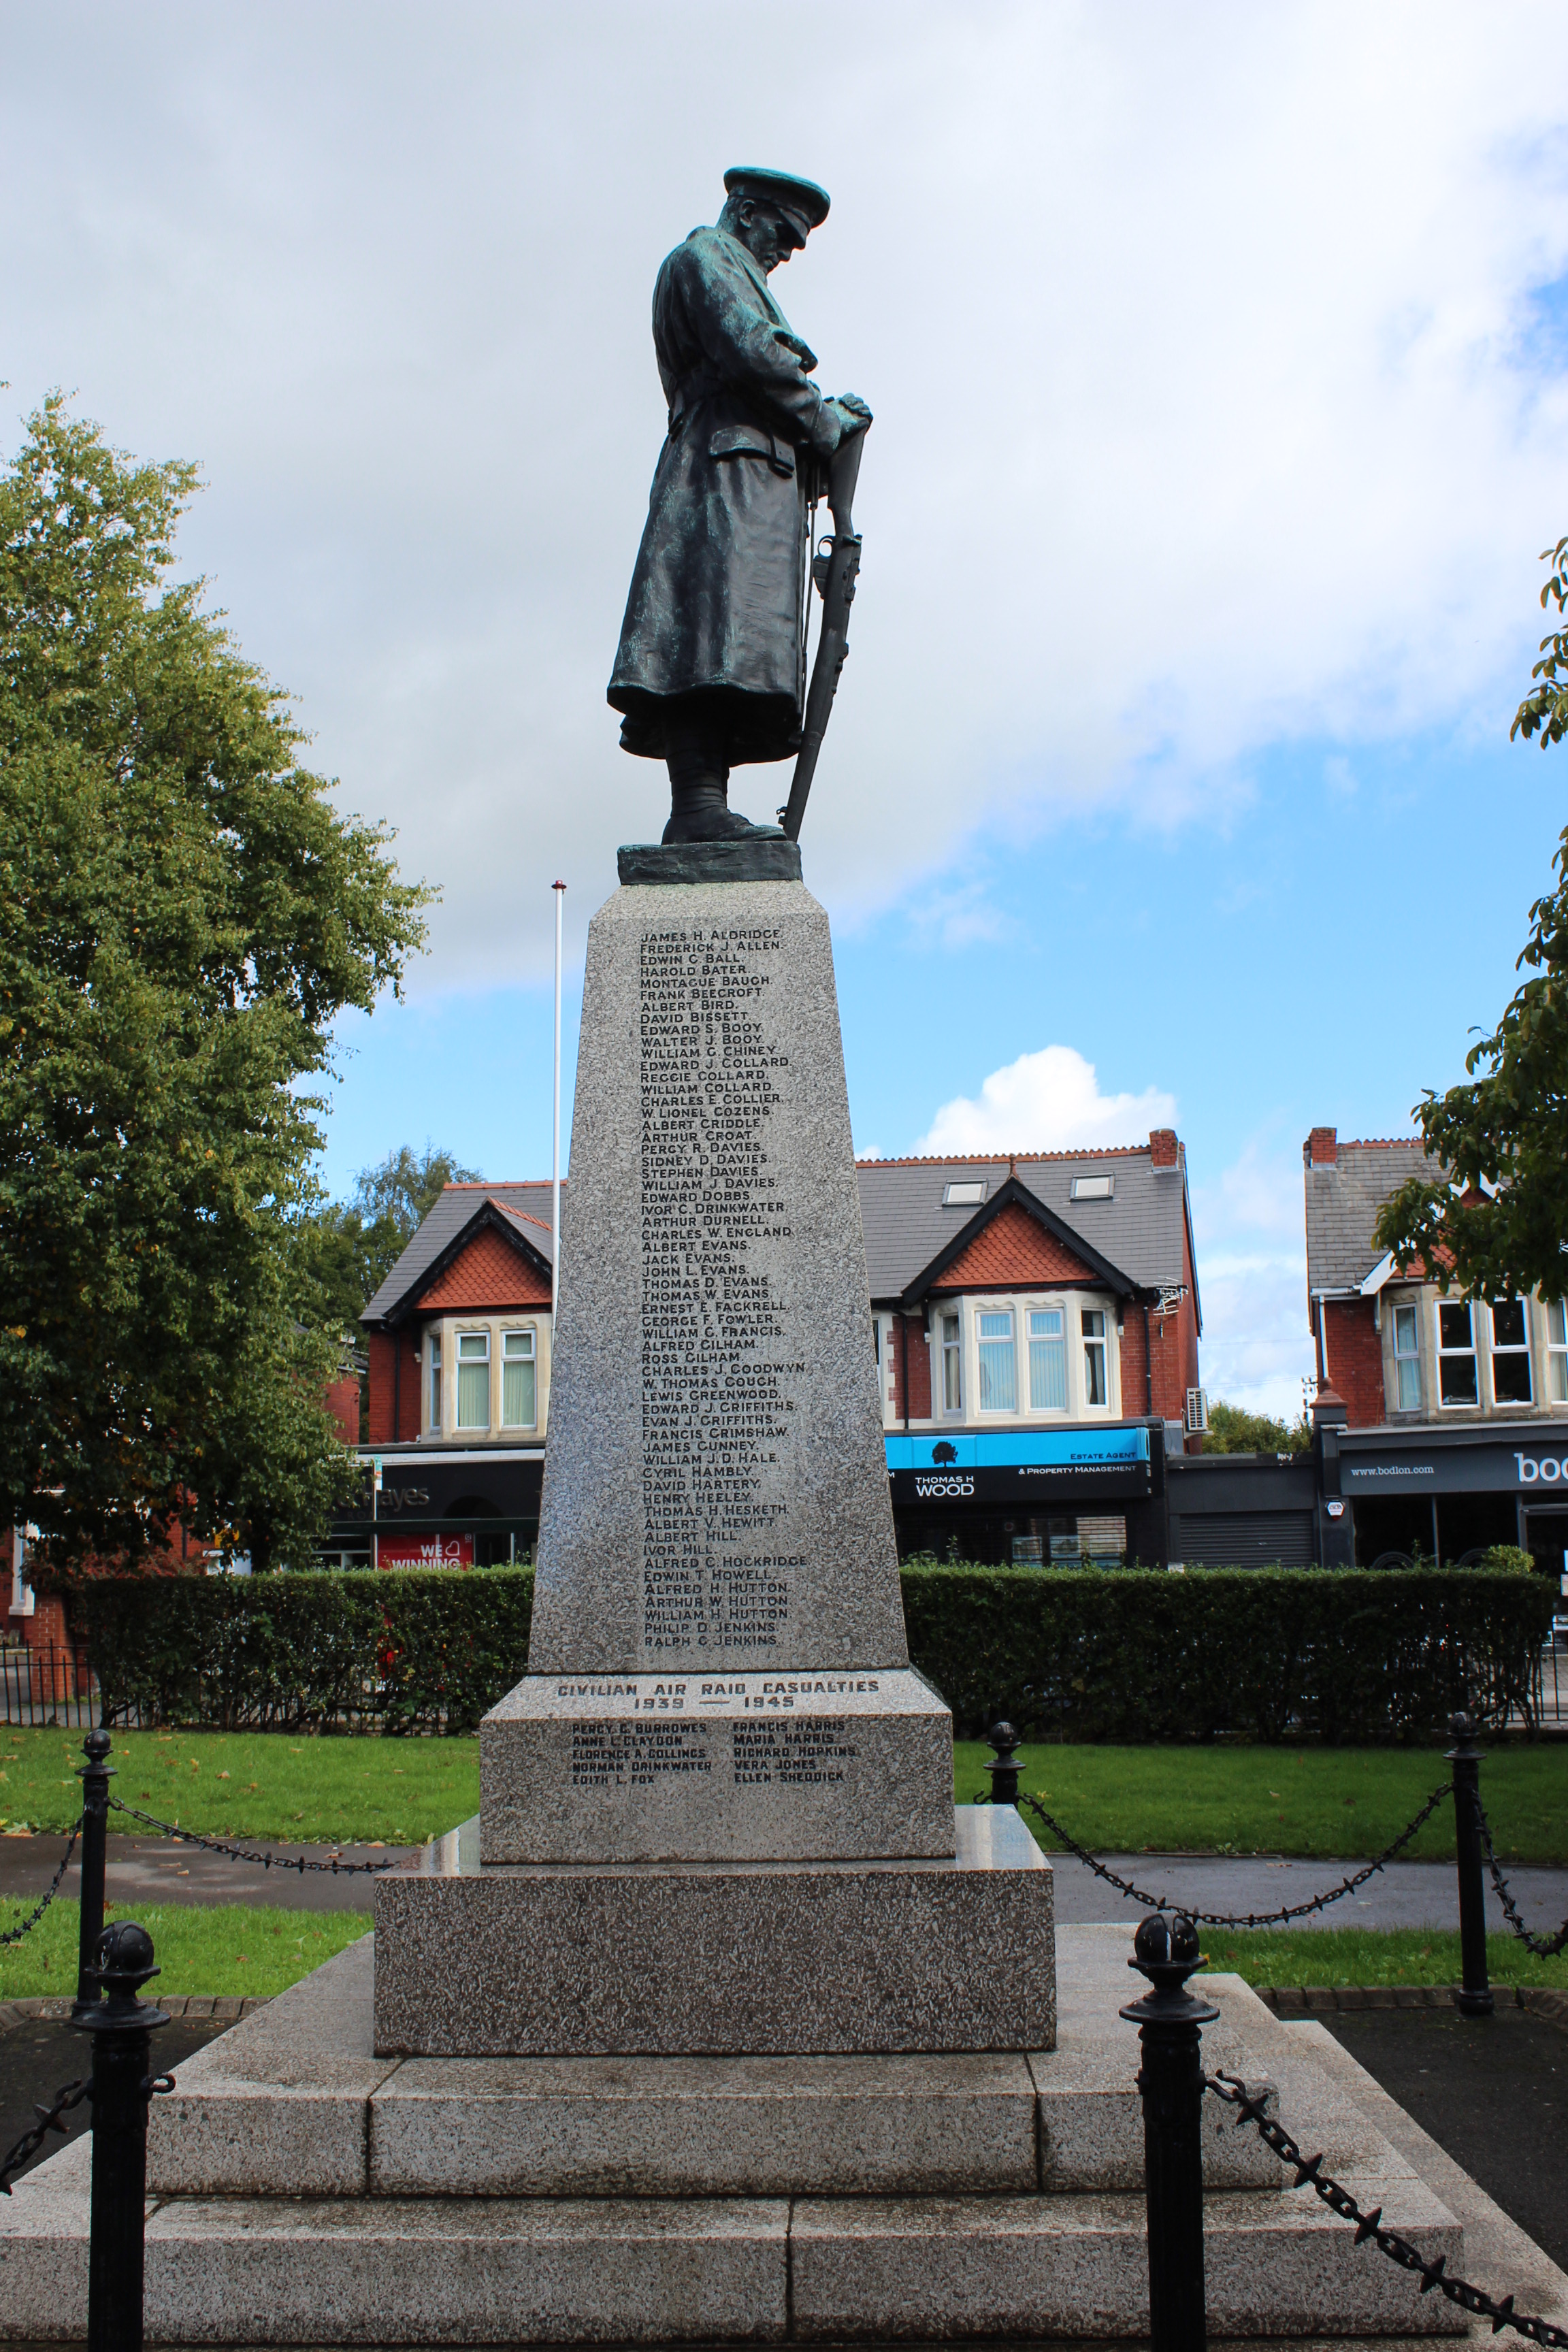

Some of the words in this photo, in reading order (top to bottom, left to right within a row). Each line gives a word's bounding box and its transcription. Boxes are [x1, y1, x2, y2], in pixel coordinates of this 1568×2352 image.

[642, 933, 686, 943] JAMES
[641, 944, 714, 954] FREDERICK
[641, 956, 682, 965] EDWIN
[641, 968, 696, 977] HAROLD
[641, 991, 685, 1000] FRANK
[642, 1002, 693, 1012] ALBERT
[641, 1014, 683, 1024] DAVID
[641, 1026, 700, 1035] EDWARD
[642, 1037, 697, 1047] WALTER
[642, 1049, 700, 1058] WILLIAM
[641, 1062, 699, 1071] EDWARD
[641, 1085, 698, 1094] WILLIAM
[641, 1097, 703, 1107] CHARLES
[660, 1109, 706, 1117] LIONEL
[642, 1121, 694, 1130] ALBERT
[642, 1133, 697, 1143] ARTHUR
[642, 1157, 692, 1166] SIDNEY
[642, 1169, 703, 1179] STEPHEN
[642, 1181, 702, 1190] WILLIAM
[642, 1193, 697, 1203] EDWARD
[642, 1206, 672, 1215] IVOR
[642, 1218, 696, 1227] ARTHUR
[642, 1230, 702, 1240] CHARLES
[642, 1242, 696, 1252] ALBERT
[642, 1256, 678, 1264] JACK
[642, 1267, 680, 1277] JOHN
[642, 1279, 699, 1289] THOMAS
[643, 1291, 700, 1302] THOMAS
[642, 1304, 693, 1314] ERNEST
[642, 1329, 698, 1339] WILLIAM
[643, 1341, 694, 1351] ALFRED
[642, 1354, 677, 1364] ROSS
[642, 1366, 708, 1376] CHARLES
[662, 1379, 717, 1388] THOMAS
[642, 1392, 682, 1401] LEWIS
[642, 1404, 698, 1414] EDWARD
[643, 1417, 678, 1427] EVAN
[643, 1430, 702, 1440] FRANCIS
[643, 1442, 690, 1452] JAMES
[643, 1454, 701, 1465] WILLIAM
[643, 1468, 685, 1477] CYRIL
[1351, 1466, 1434, 1476] www.bodlon.com
[644, 1481, 685, 1491] DAVID
[916, 1484, 974, 1497] WOOD
[644, 1493, 690, 1504] HENRY
[644, 1506, 702, 1517] THOMAS
[644, 1519, 698, 1530] ALBERT
[644, 1532, 698, 1542] ALBERT
[421, 1544, 442, 1557] WE
[644, 1545, 675, 1556] IVOR
[391, 1558, 460, 1570] WINNING
[644, 1558, 699, 1569] ALFRED
[644, 1571, 689, 1582] EDWIN
[644, 1584, 702, 1595] ALFRED
[645, 1597, 703, 1607] ARTHUR
[645, 1610, 704, 1621] WILLIAM
[645, 1623, 689, 1634] PHILIP
[645, 1637, 690, 1647] RALPH
[558, 1684, 637, 1696] CIVILIAN
[655, 1684, 686, 1695] AIR
[702, 1683, 746, 1695] RAID
[763, 1681, 879, 1693] CASUALTIES
[635, 1698, 684, 1709] 1939
[745, 1697, 794, 1708] 1945
[572, 1723, 612, 1734] PERCY
[636, 1723, 707, 1733] BURROWES
[733, 1721, 788, 1732] FRANCIS
[796, 1721, 845, 1731] HARRIS
[573, 1736, 605, 1746] ANNE
[611, 1736, 621, 1746] L.
[624, 1735, 682, 1746] CLAYDON
[734, 1734, 775, 1745] MARIA
[785, 1734, 834, 1744] HARRIS
[573, 1750, 630, 1759] FLORENCE
[635, 1750, 646, 1759] A.
[734, 1747, 789, 1757] RICHARD
[799, 1746, 855, 1757] HOPKINS
[573, 1762, 623, 1772] NORMAN
[632, 1761, 711, 1771] DRINKWATER
[734, 1760, 768, 1770] VERA
[775, 1760, 816, 1769] JONES
[573, 1775, 608, 1785] EDITH
[617, 1775, 627, 1784] L.
[632, 1774, 655, 1784] FOX
[735, 1773, 771, 1782] ELLEN
[780, 1771, 844, 1782] SHEDDICK
